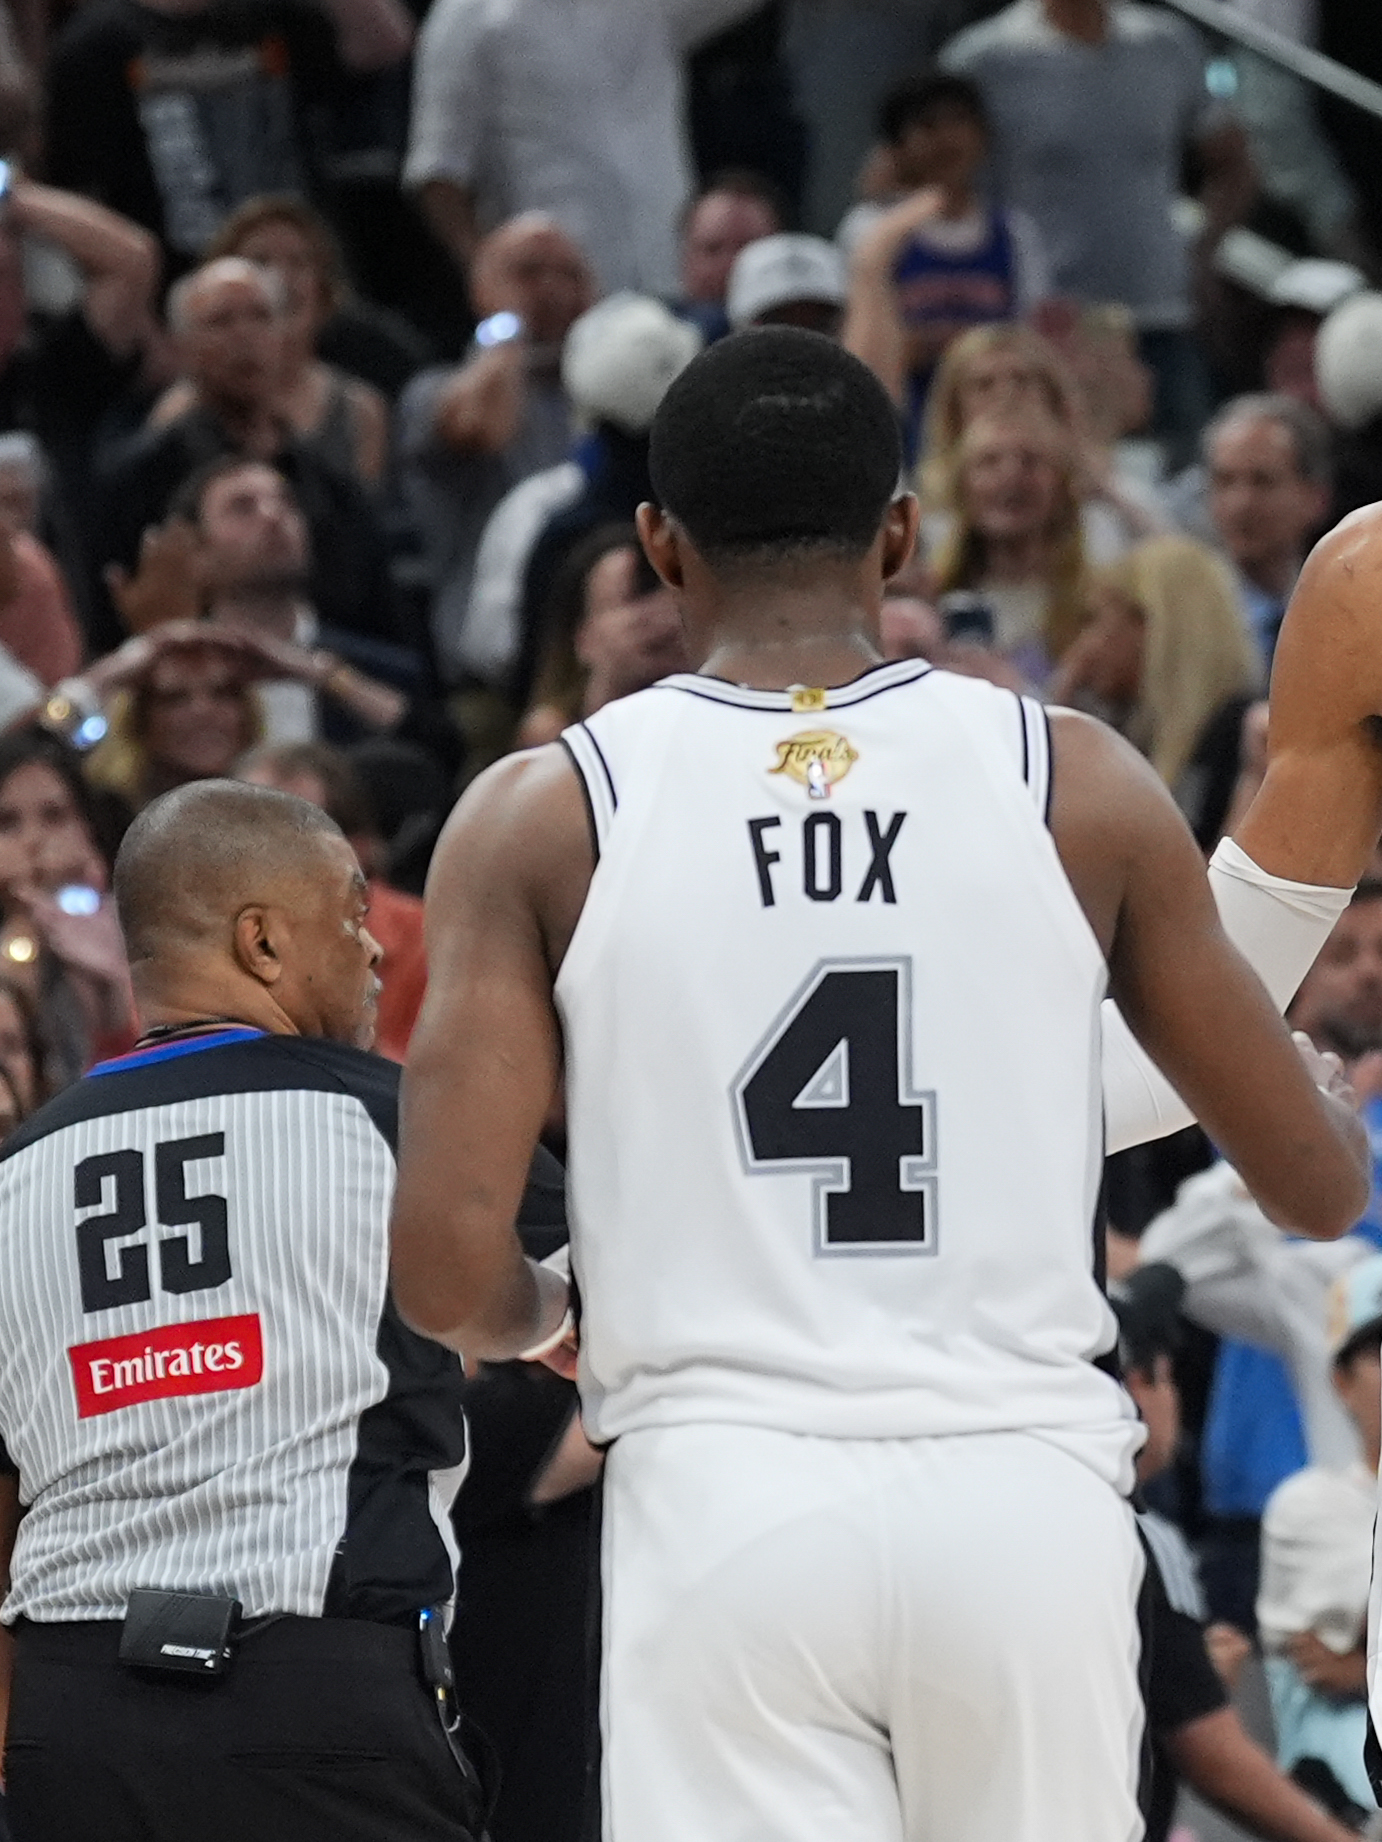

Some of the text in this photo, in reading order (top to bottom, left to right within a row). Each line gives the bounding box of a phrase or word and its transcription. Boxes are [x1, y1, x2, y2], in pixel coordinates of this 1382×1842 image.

[767, 736, 859, 773] Finals
[747, 809, 907, 908] FOX
[728, 956, 937, 1257] 4
[74, 1131, 232, 1313] 25
[89, 1341, 243, 1395] Emirates
